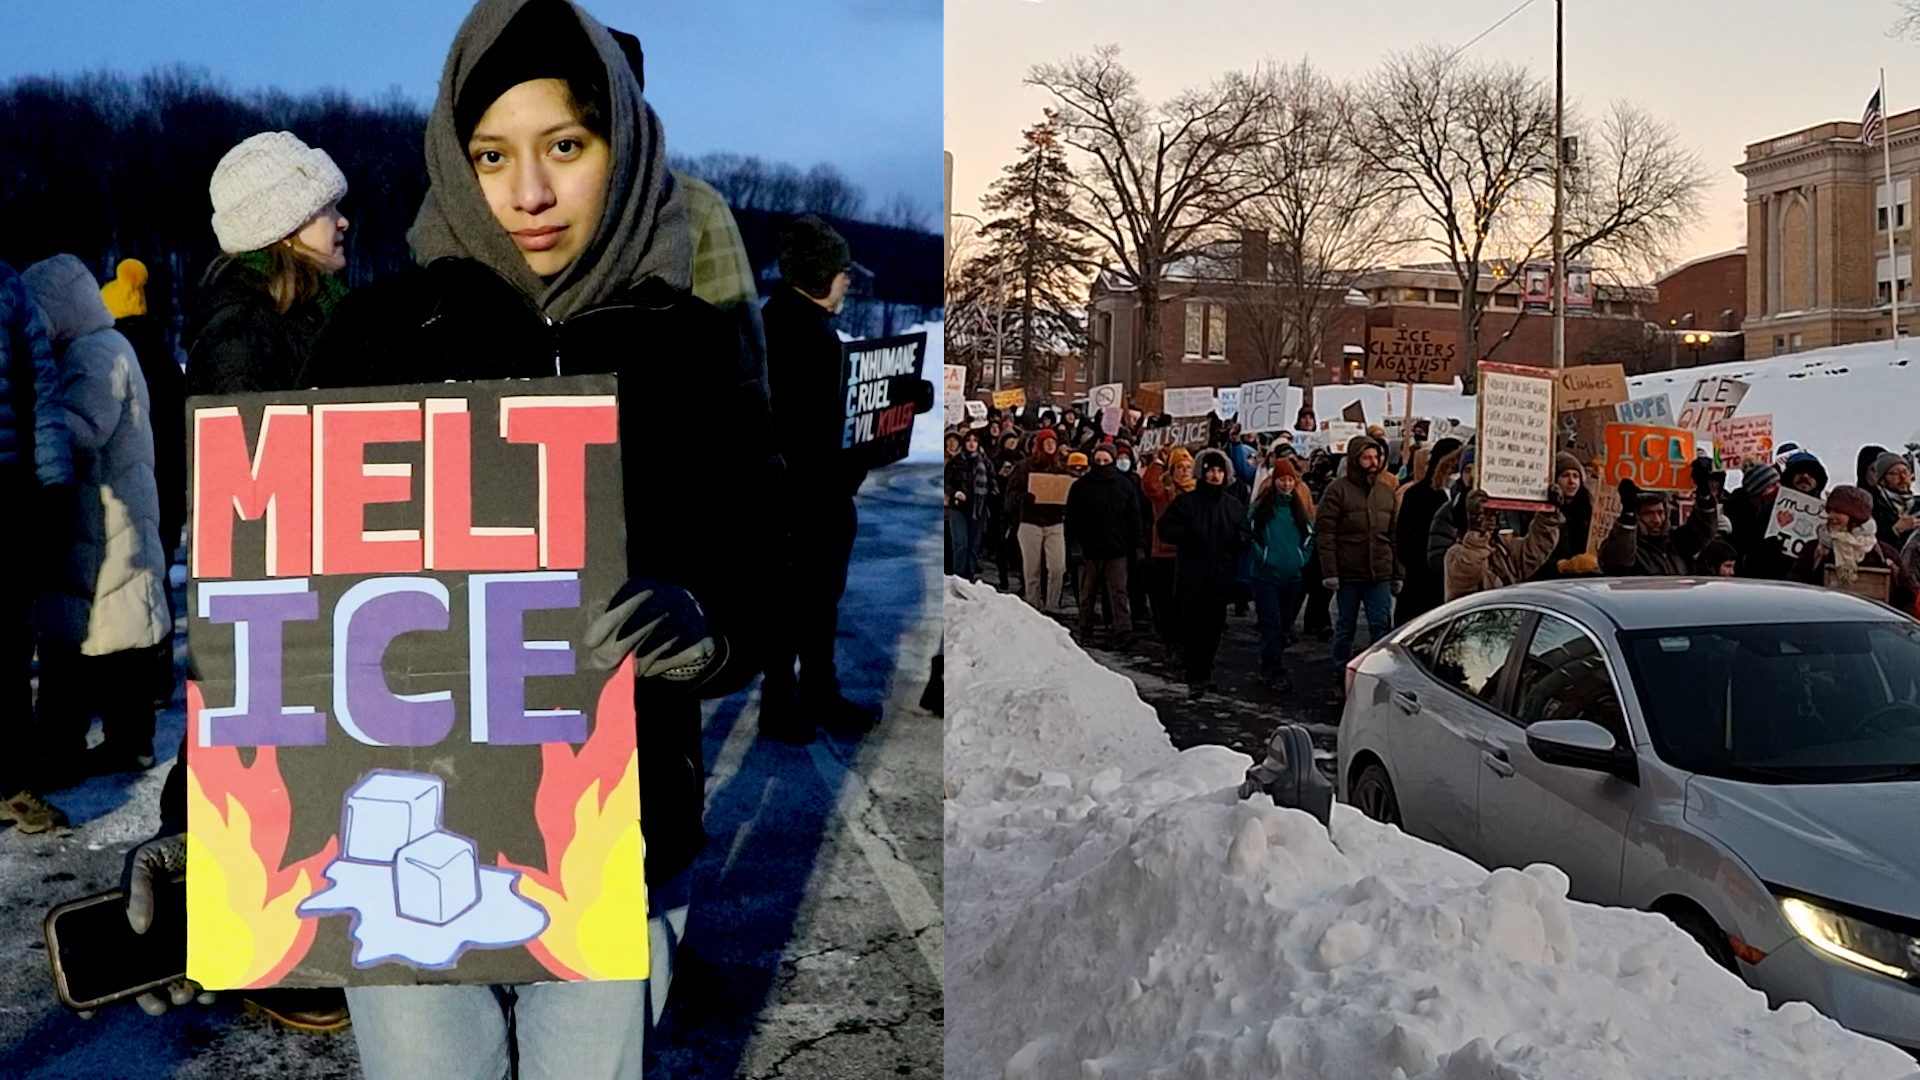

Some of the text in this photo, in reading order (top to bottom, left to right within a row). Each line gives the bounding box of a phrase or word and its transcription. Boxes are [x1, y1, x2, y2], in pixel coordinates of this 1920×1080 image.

[1397, 329, 1430, 342] ICE
[1371, 341, 1456, 358] CLIMBERS
[847, 342, 918, 386] INHUMANE
[1375, 354, 1451, 372] AGAINST
[1396, 370, 1429, 383] ICE
[1562, 374, 1612, 391] Climbers
[845, 379, 890, 418] CRUEL
[1222, 392, 1237, 400] NY
[1243, 381, 1281, 404] HEX
[1244, 403, 1282, 430] ICE
[1619, 396, 1666, 422] HOPE
[841, 413, 874, 449] EVIL
[1185, 421, 1208, 445] ICE
[1615, 461, 1686, 487] OUT
[193, 396, 617, 578] MELT
[198, 571, 588, 747] ICE
